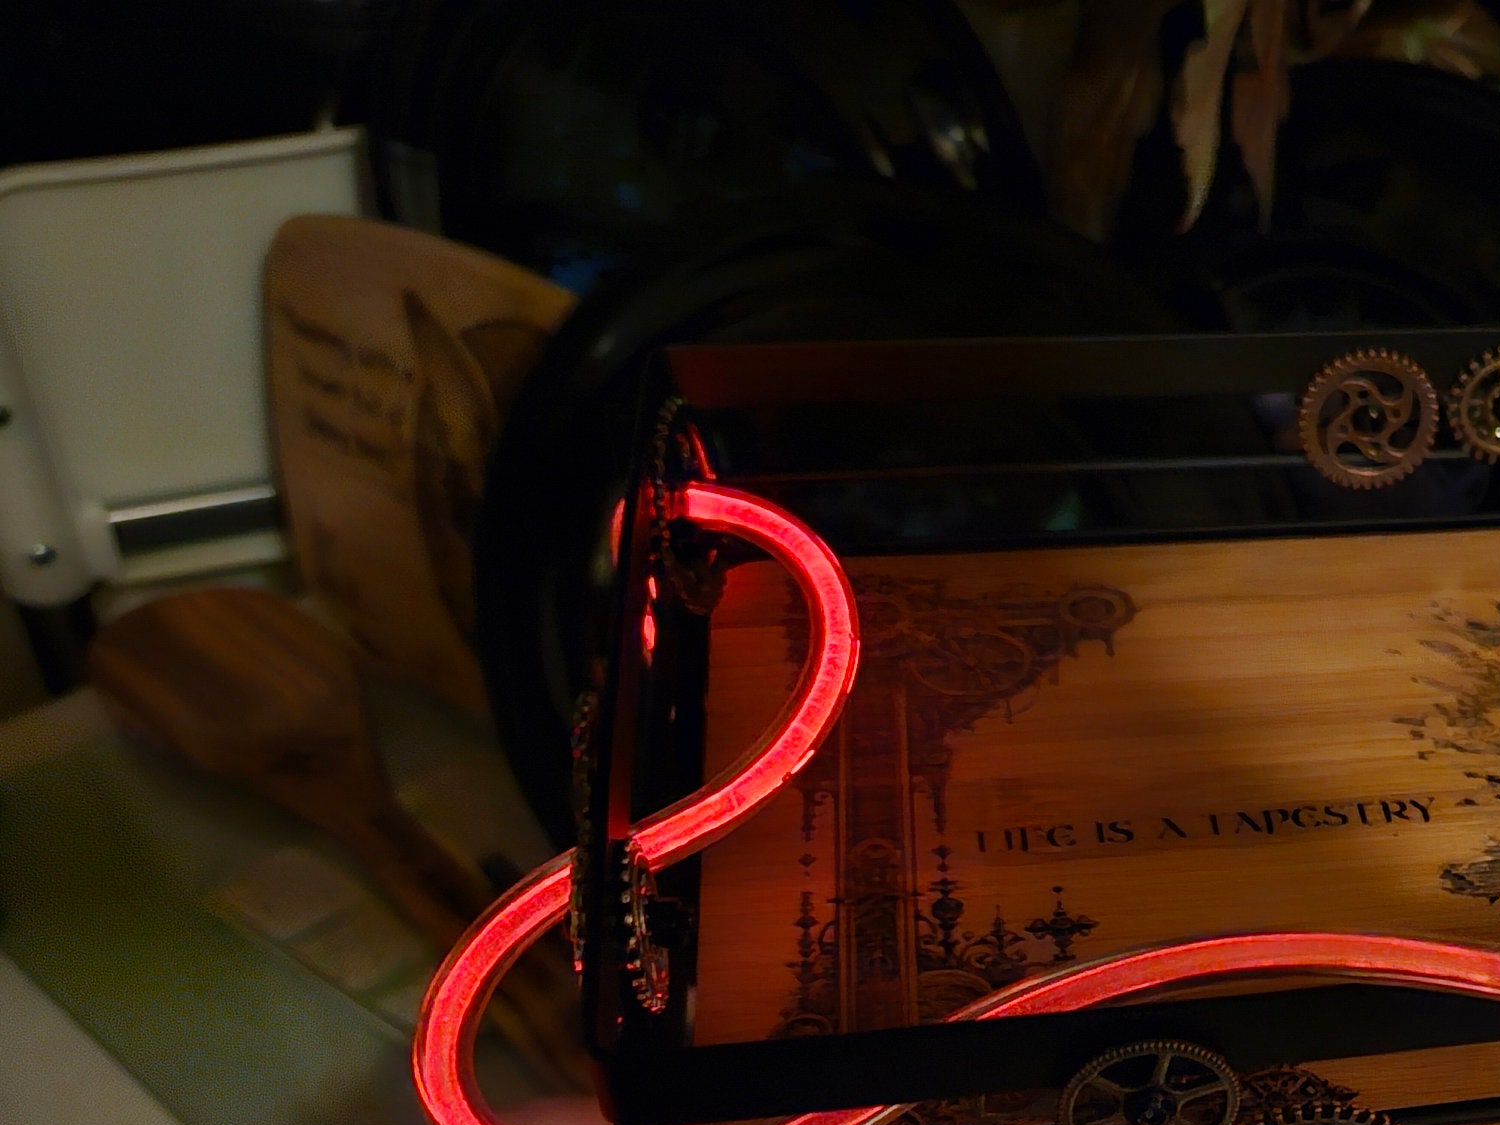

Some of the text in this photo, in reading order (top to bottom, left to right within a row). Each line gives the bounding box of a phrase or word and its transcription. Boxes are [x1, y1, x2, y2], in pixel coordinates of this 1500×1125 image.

[975, 796, 1438, 854] LIFE IS A TAPESTRY
